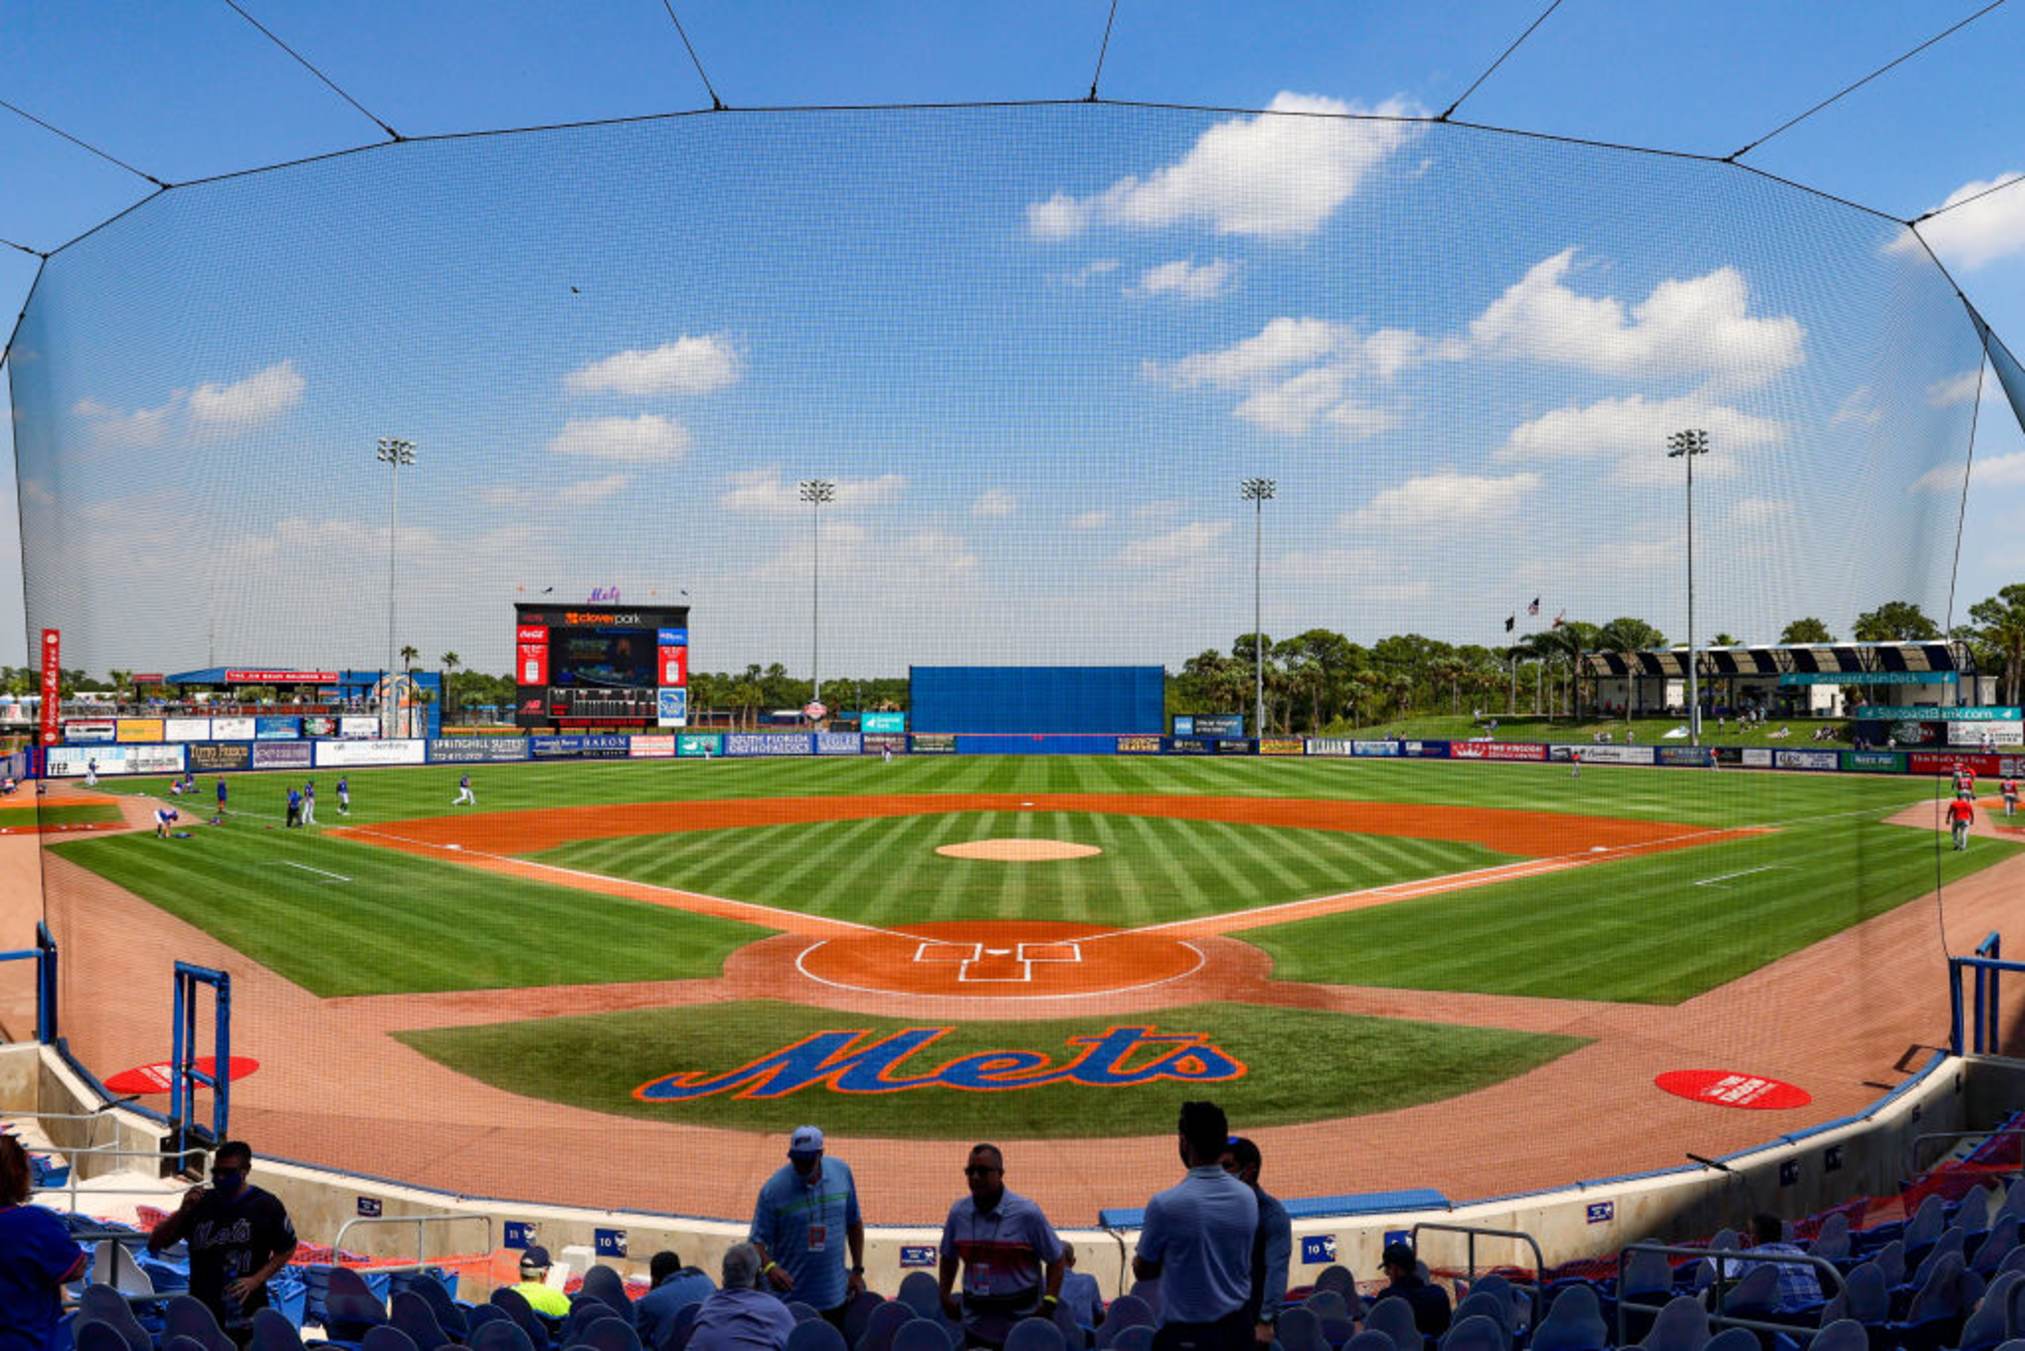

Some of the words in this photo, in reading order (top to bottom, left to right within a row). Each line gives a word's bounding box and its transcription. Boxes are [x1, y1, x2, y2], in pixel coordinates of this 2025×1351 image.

[587, 585, 620, 603] Mets
[579, 613, 615, 624] clover
[615, 613, 641, 625] park
[1879, 708, 1993, 719] SeacoastBank.com
[433, 738, 489, 749] SPRINGHILL
[632, 1026, 1248, 1102] Mets
[509, 1230, 518, 1239] 11
[600, 1237, 611, 1247] 10
[1308, 1244, 1320, 1254] 10
